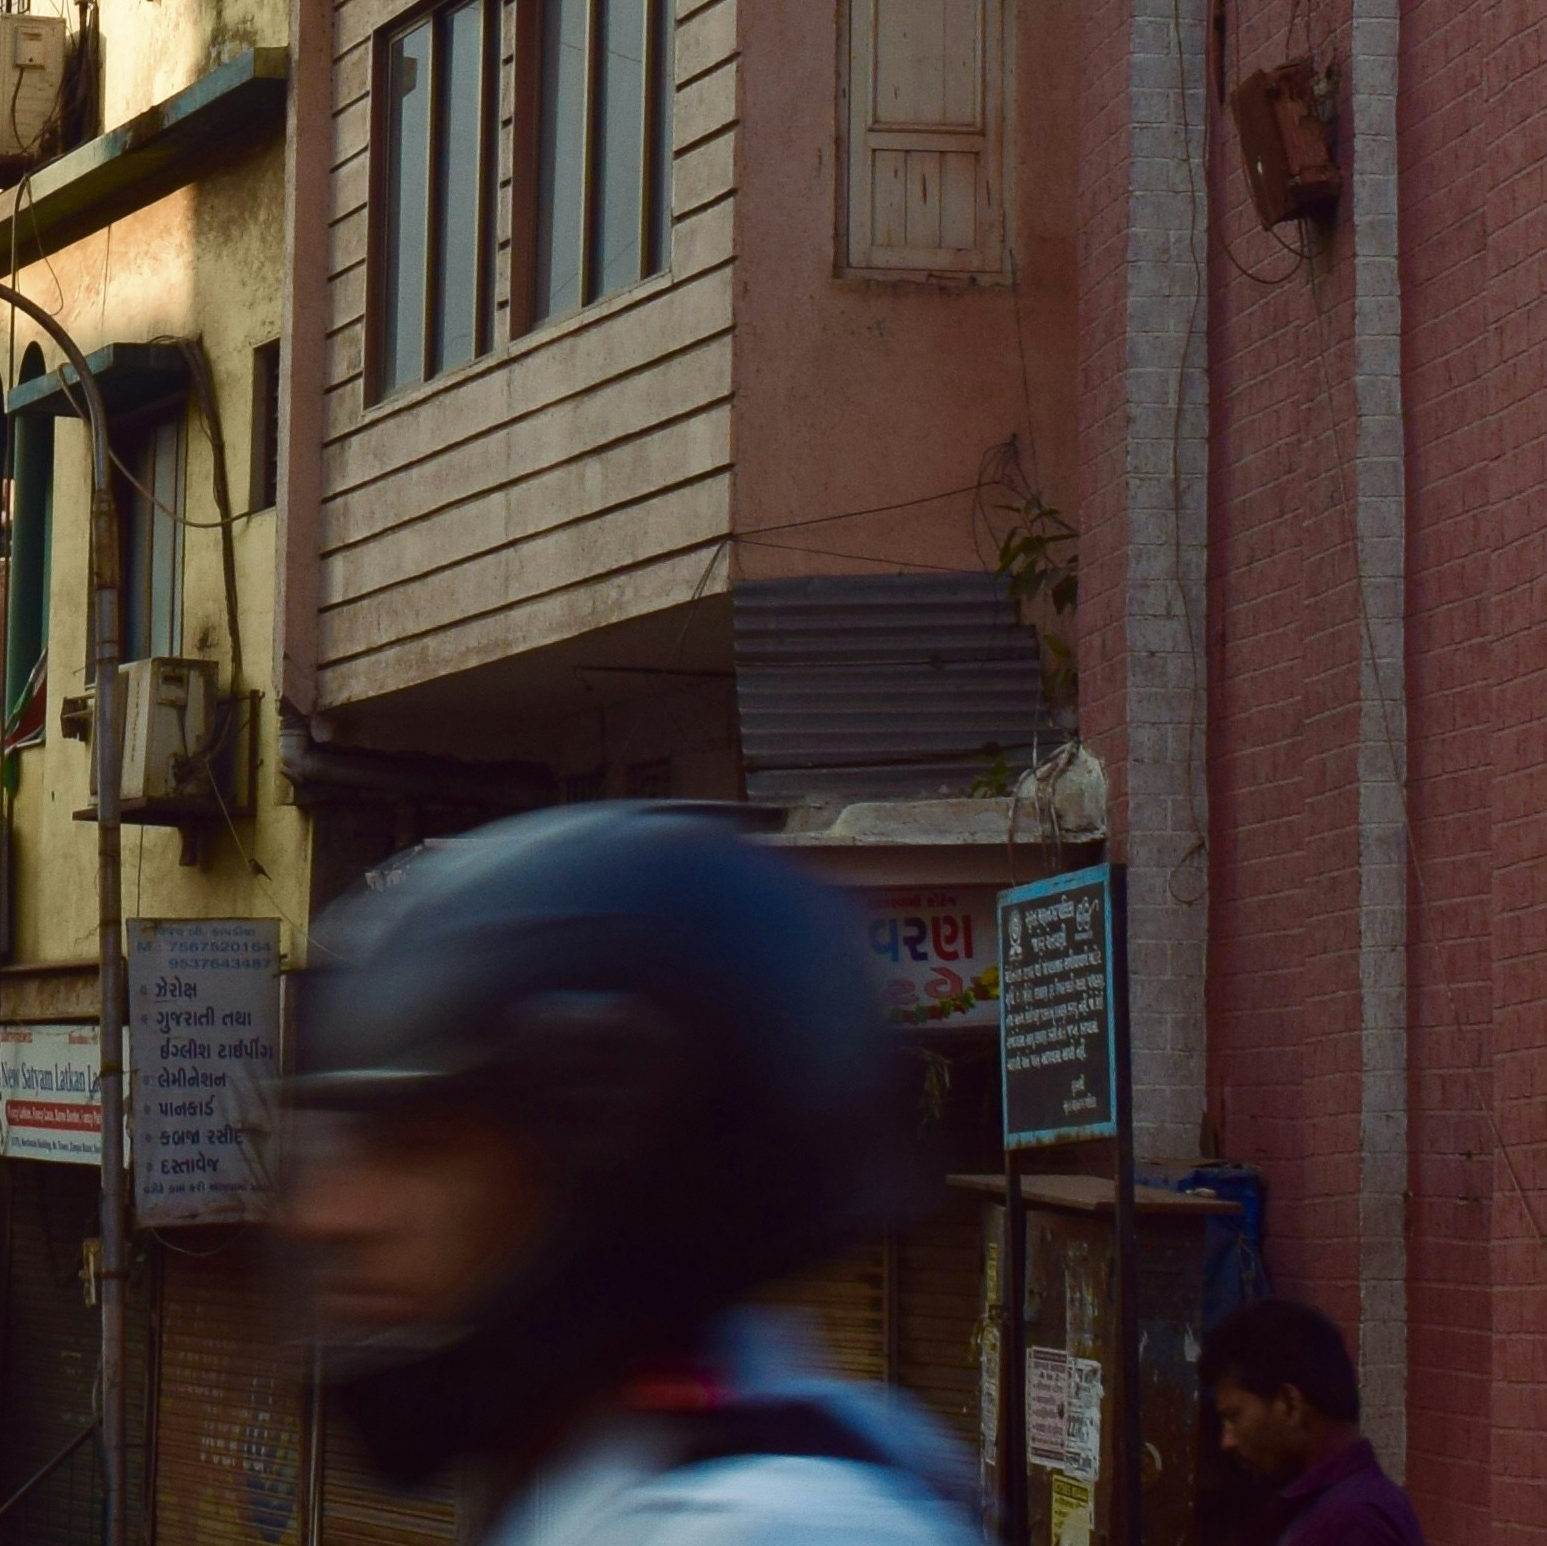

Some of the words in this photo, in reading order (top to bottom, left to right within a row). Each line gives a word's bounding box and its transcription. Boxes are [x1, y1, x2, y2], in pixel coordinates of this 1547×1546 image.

[156, 976, 197, 999] ઝેરોક્ષ
[156, 1005, 214, 1033] ગુજરાતી
[222, 1011, 252, 1026] તથા
[21, 1061, 53, 1097] Satyam
[55, 1061, 86, 1093] Latkan
[158, 1065, 227, 1088] લેમીનેશન
[159, 1094, 216, 1117] પાનકાર્ડ
[161, 1151, 220, 1175] દસ્તાવેજ
